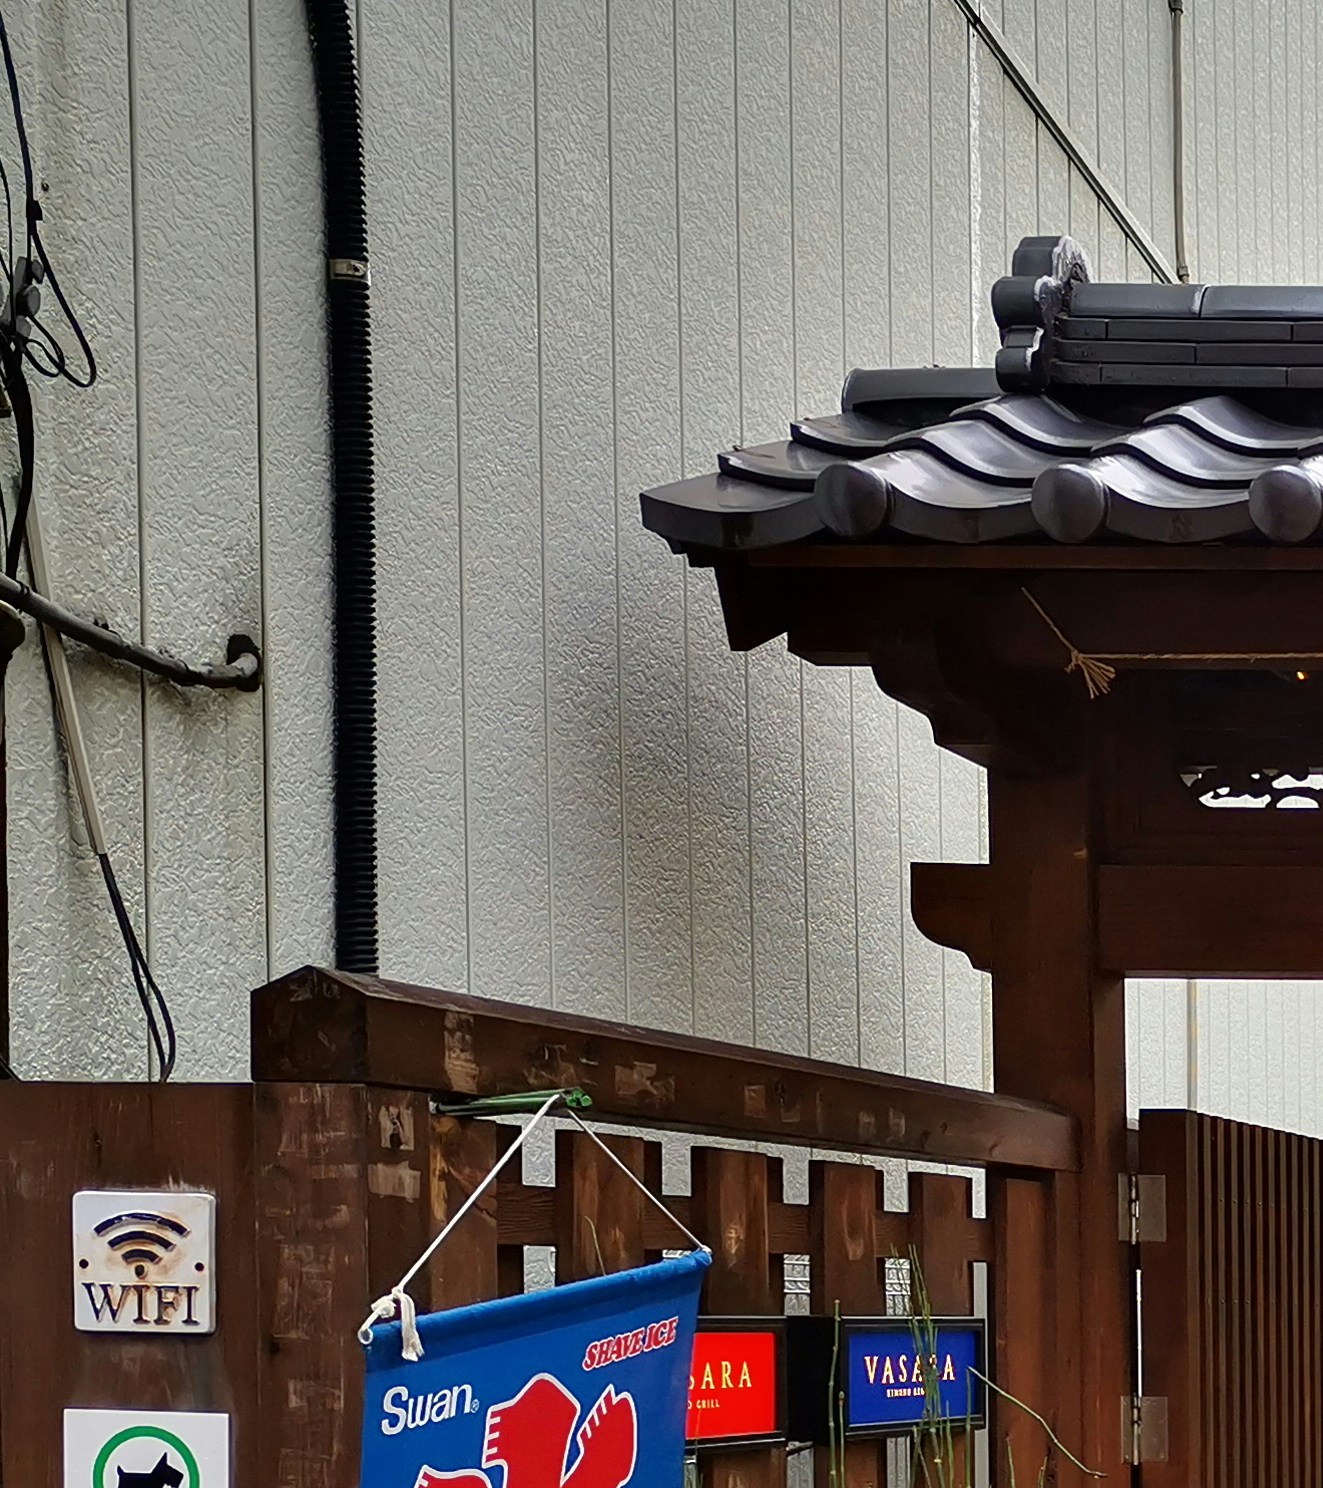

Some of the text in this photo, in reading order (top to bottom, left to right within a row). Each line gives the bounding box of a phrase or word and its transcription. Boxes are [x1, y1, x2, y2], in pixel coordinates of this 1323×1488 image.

[82, 1282, 200, 1325] WIFI
[583, 1316, 679, 1372] SHAVE ICE
[696, 1399, 720, 1410] GRILL
